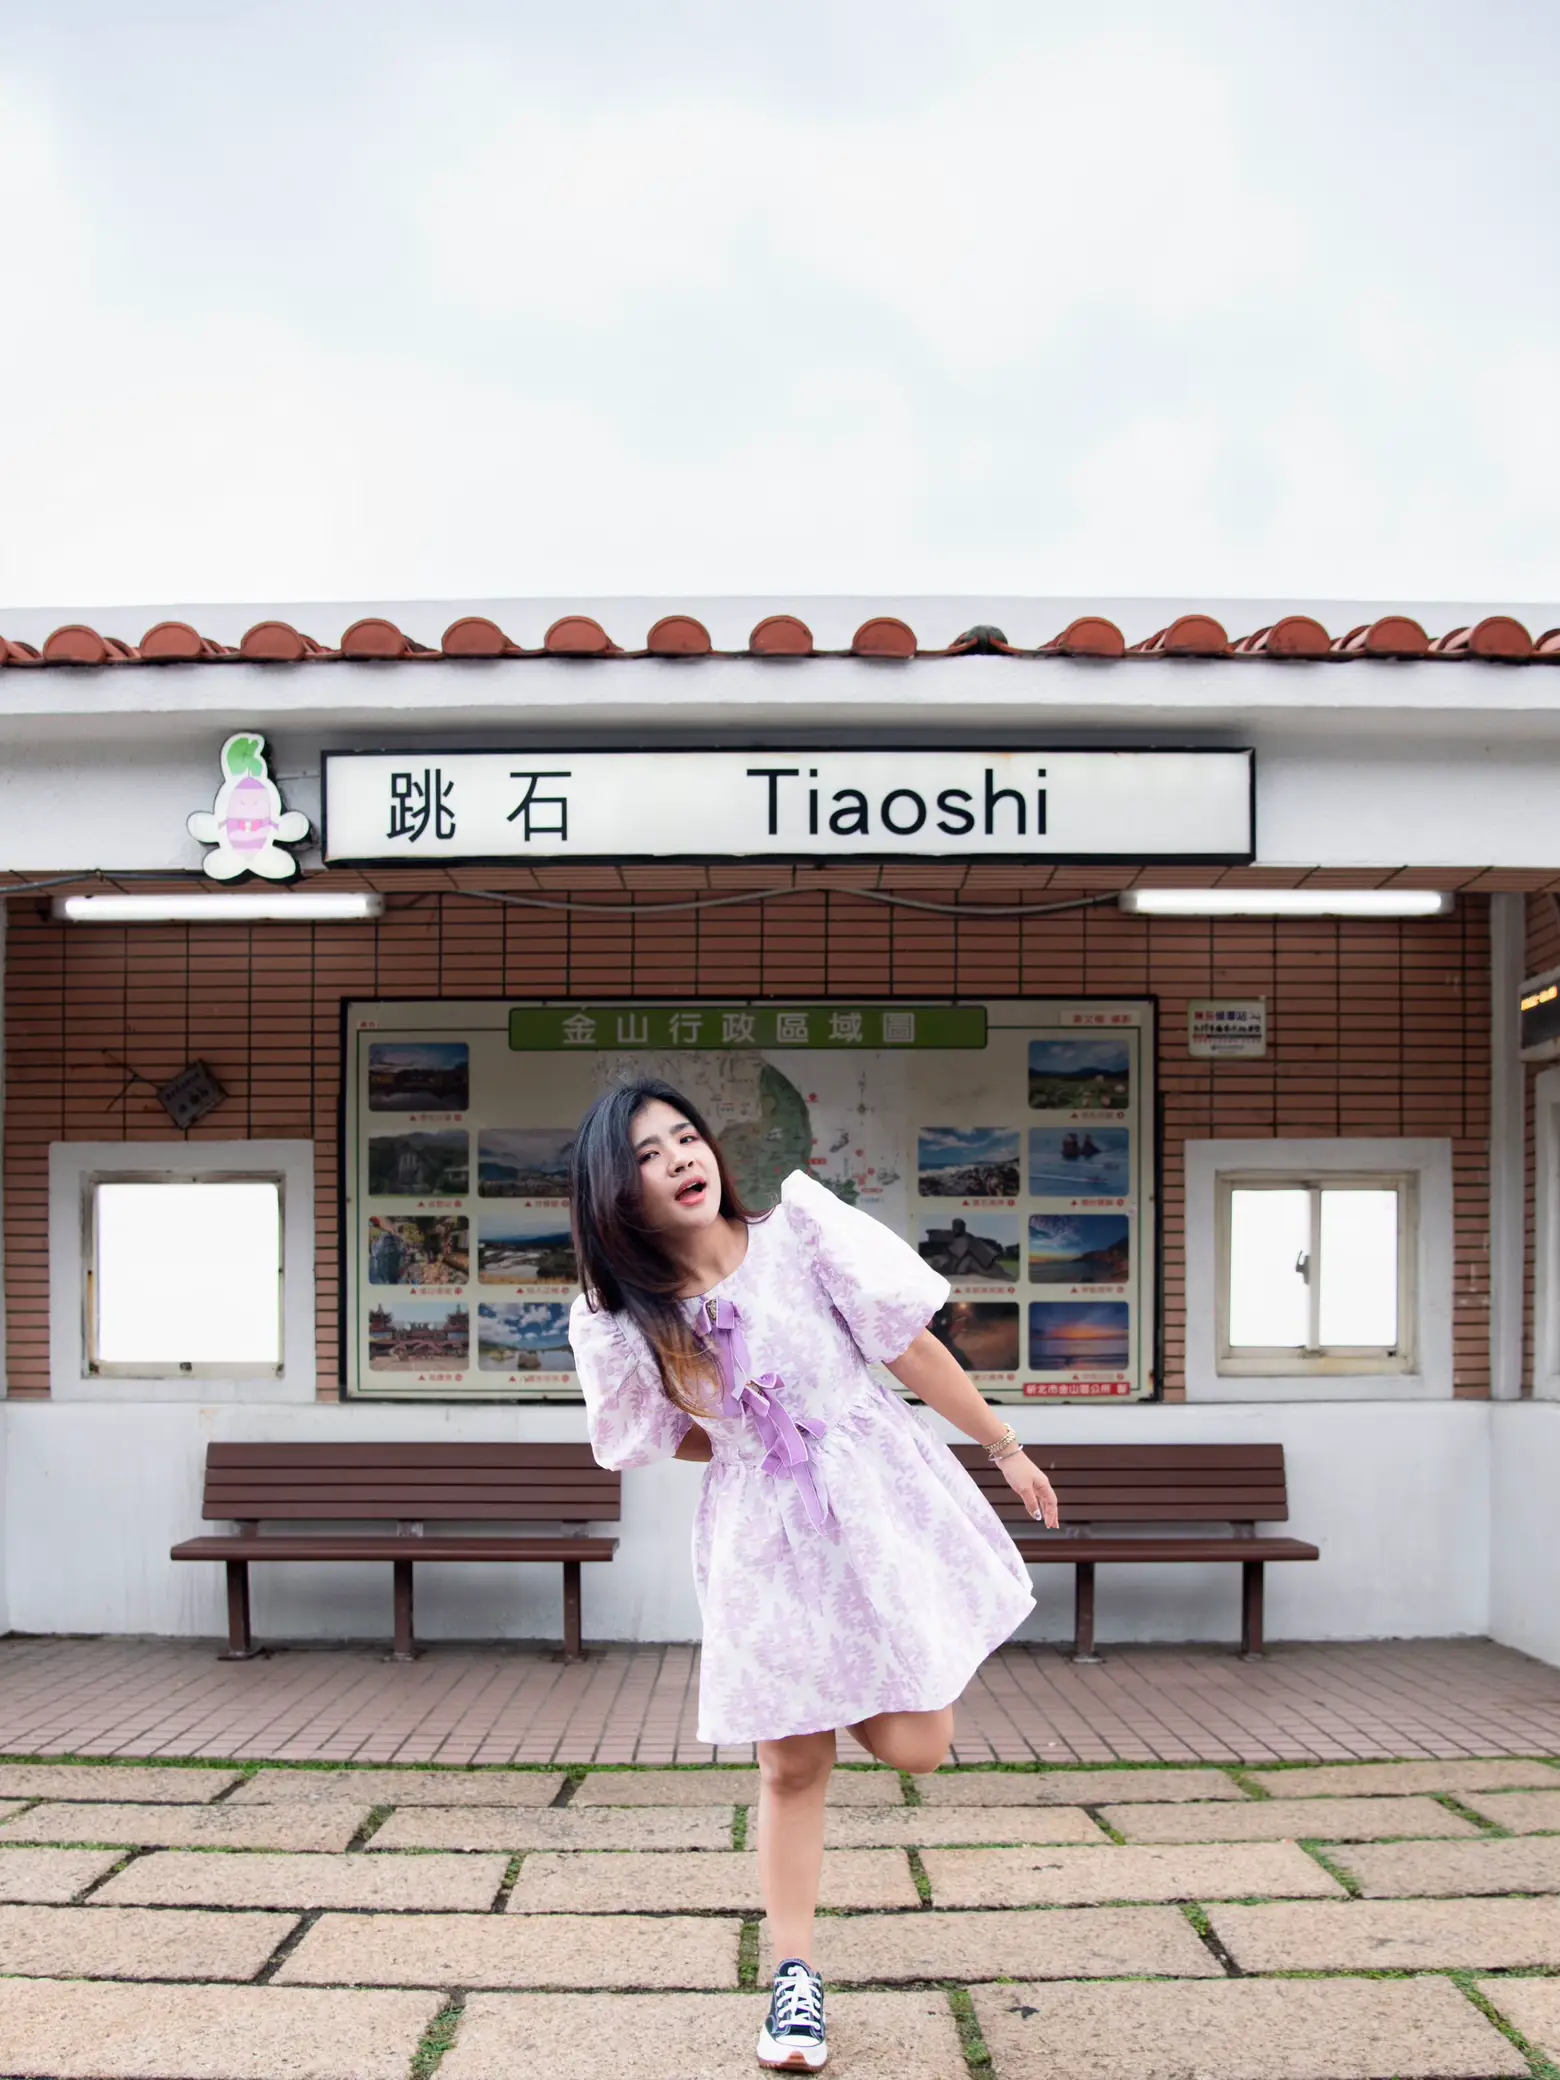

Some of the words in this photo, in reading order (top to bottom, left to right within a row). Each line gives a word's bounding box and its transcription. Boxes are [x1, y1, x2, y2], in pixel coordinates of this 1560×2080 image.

[387, 769, 571, 842] 跳石
[746, 768, 1047, 836] Tiaoshi
[562, 1012, 915, 1044] 金山行政區域圖
